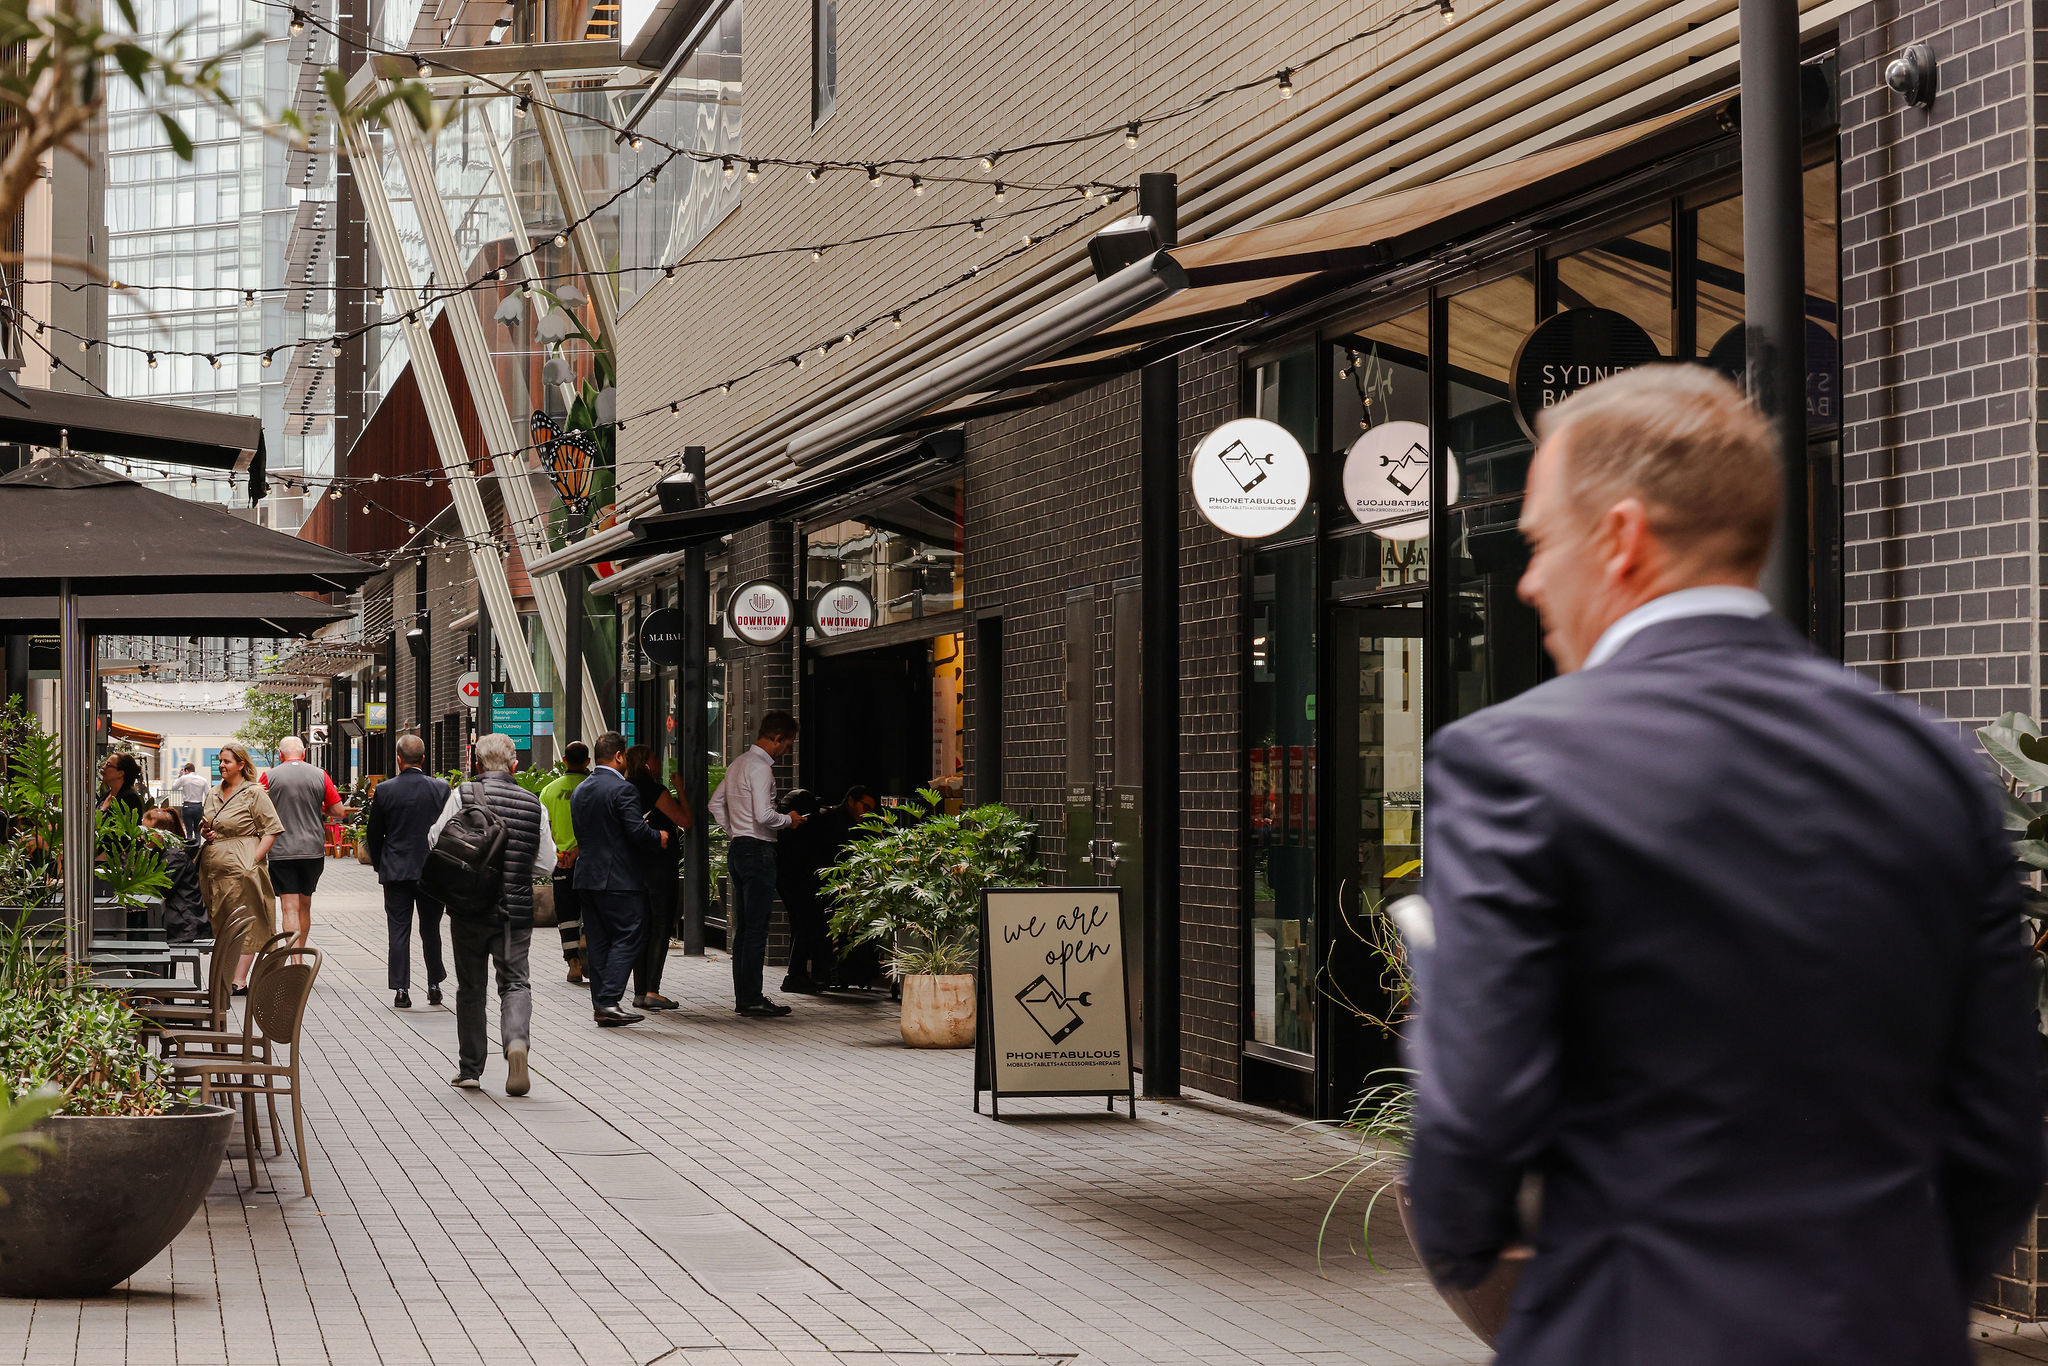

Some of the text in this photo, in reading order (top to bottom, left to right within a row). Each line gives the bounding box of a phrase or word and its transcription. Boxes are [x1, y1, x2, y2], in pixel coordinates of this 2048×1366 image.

[1543, 364, 1635, 385] SYDN
[1208, 497, 1297, 505] PHONETABULOUS
[737, 616, 786, 626] DOWNTOWN
[1004, 905, 1108, 943] we are
[1045, 940, 1110, 985] open
[1006, 1050, 1121, 1060] PHONETABULOUS
